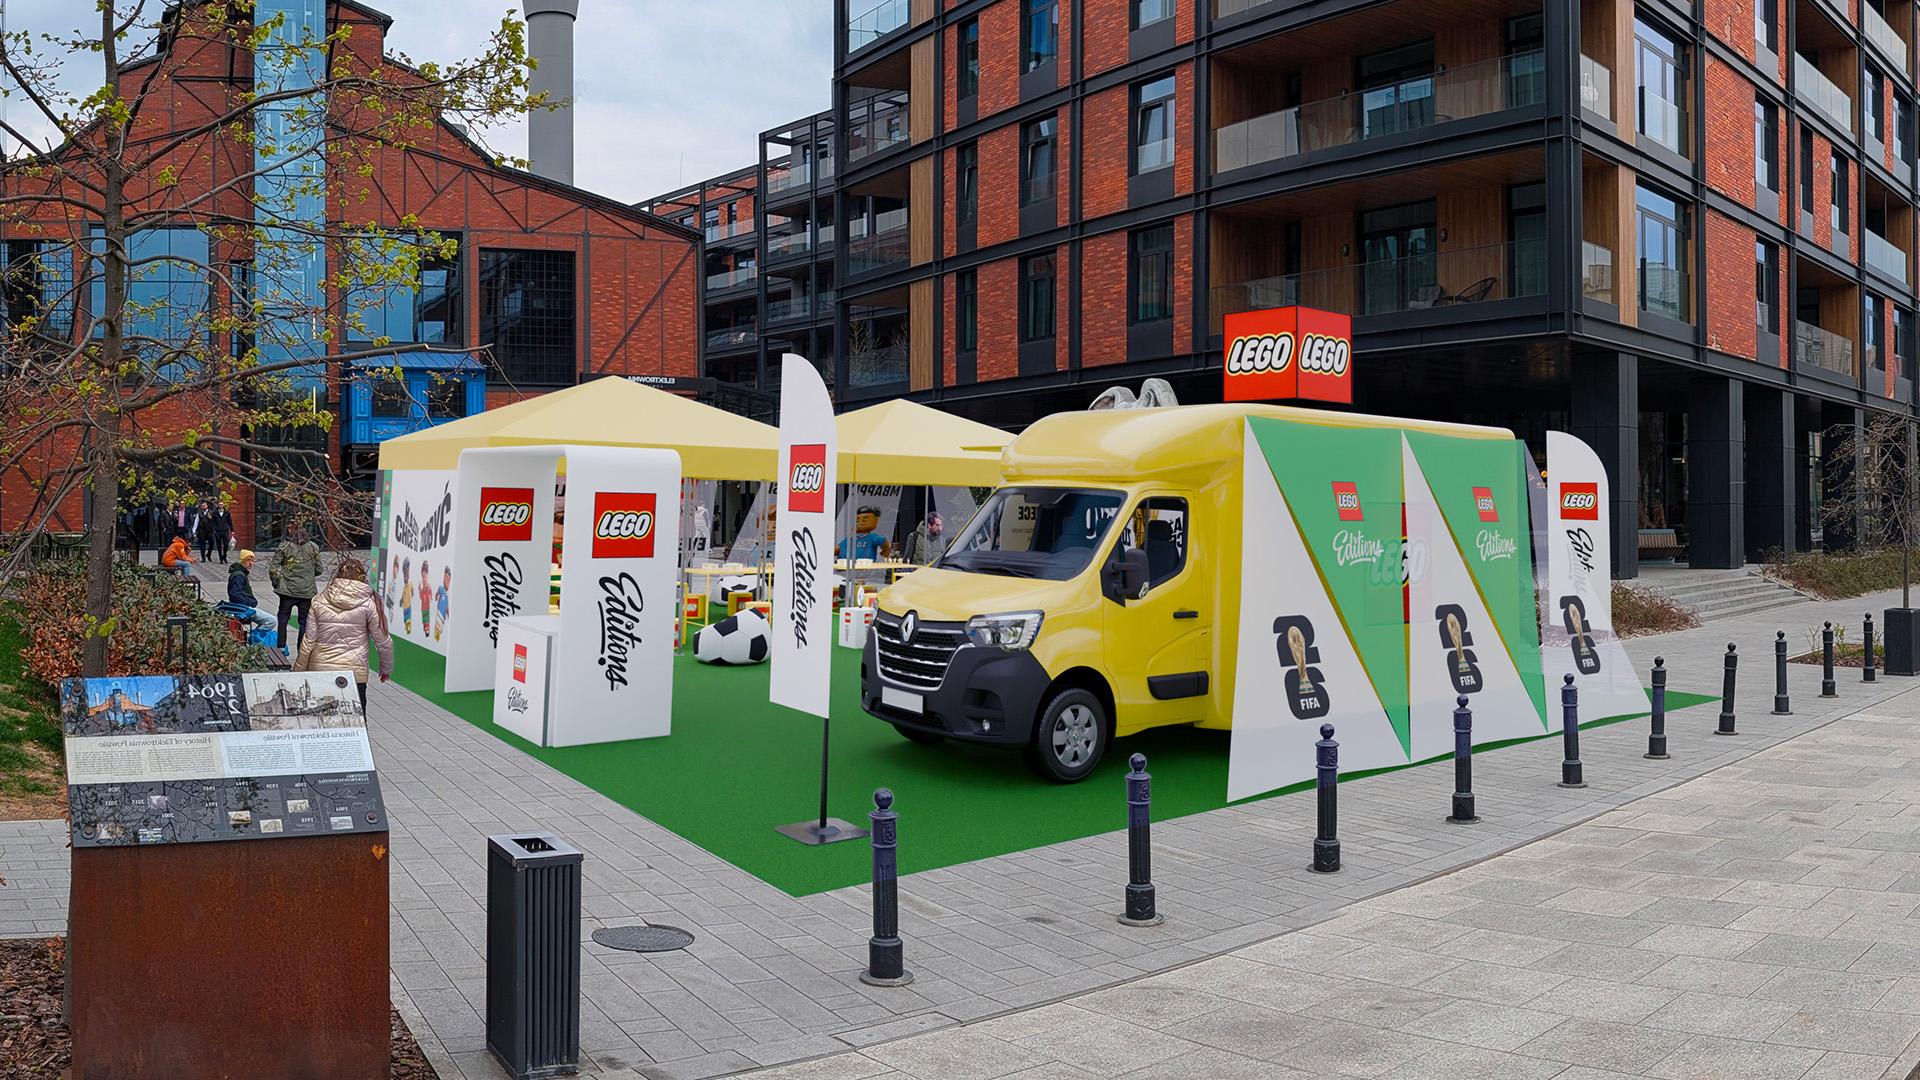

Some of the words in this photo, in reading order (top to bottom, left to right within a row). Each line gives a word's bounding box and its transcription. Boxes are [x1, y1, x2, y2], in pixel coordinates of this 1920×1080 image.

[1227, 333, 1293, 375] LEGO
[1299, 334, 1350, 376] LEGO
[791, 464, 823, 491] LEGO
[482, 503, 530, 525] LEGO
[1338, 493, 1358, 509] LEGO
[1478, 497, 1494, 511] LEGO
[1562, 493, 1594, 509] LEGO
[597, 511, 652, 539] LEGO
[1333, 530, 1384, 566] Editions
[1477, 530, 1517, 561] Editions
[791, 527, 817, 650] Editions
[598, 572, 643, 691] Editions
[1582, 658, 1595, 668] FIFA
[1460, 675, 1476, 686] FIFA
[1300, 697, 1320, 710] FIFA
